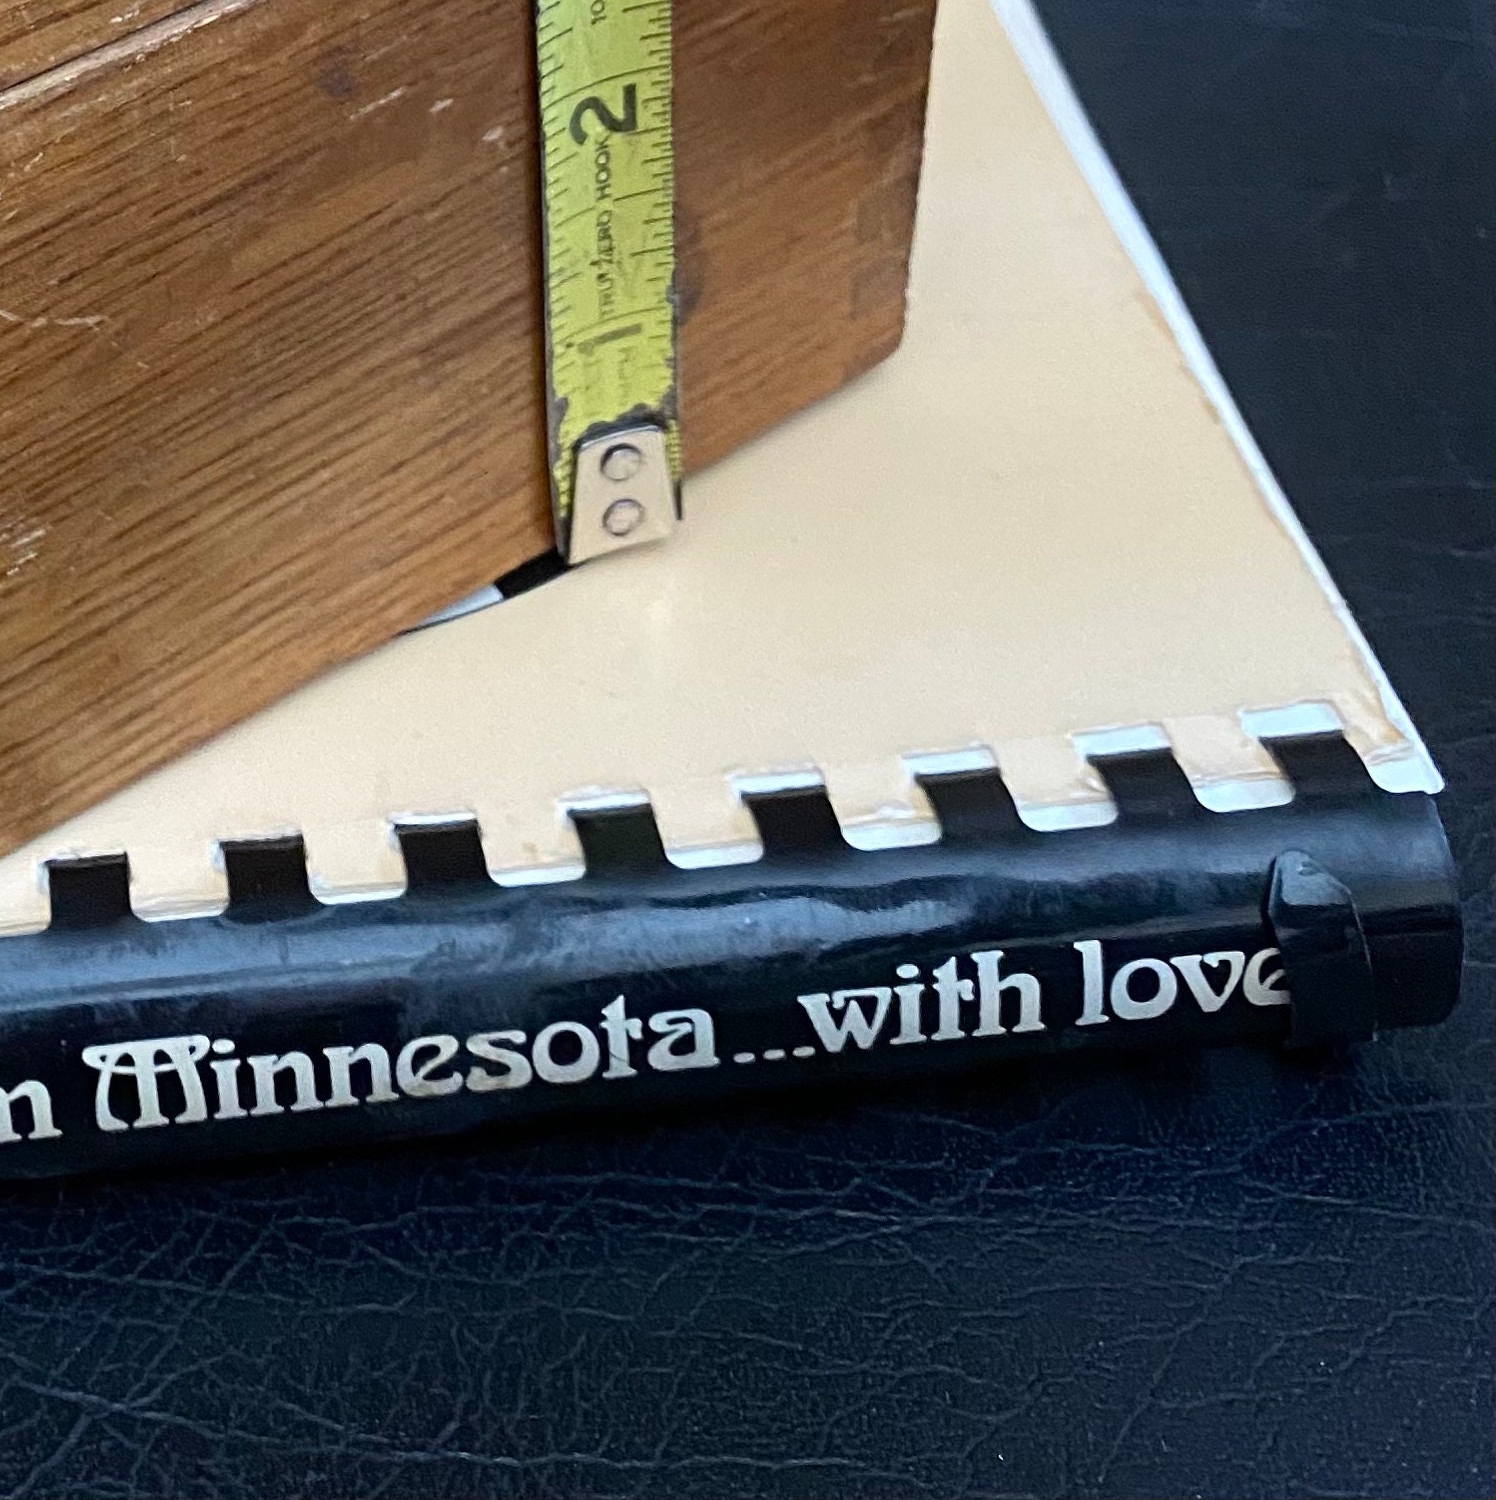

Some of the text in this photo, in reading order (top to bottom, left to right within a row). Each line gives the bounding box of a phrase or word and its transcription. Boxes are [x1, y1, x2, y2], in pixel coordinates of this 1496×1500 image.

[590, 0, 608, 25] 10
[568, 82, 639, 146] 2
[594, 134, 613, 201] HOOK
[1073, 939, 1292, 1027] love
